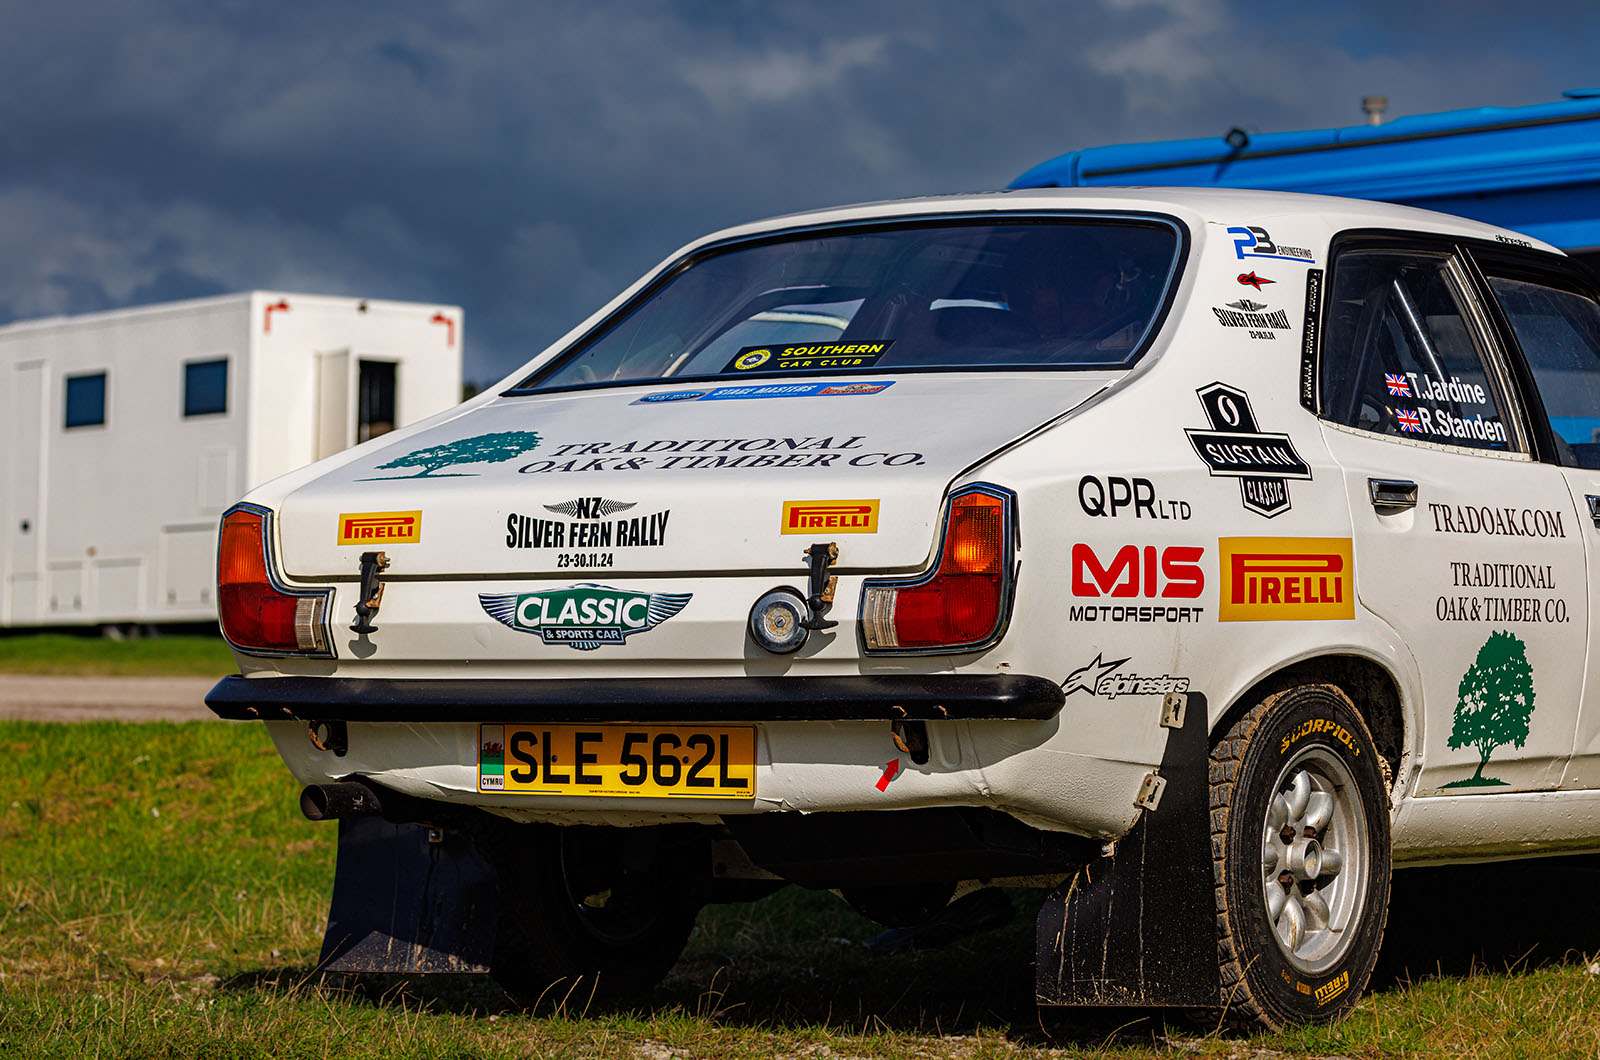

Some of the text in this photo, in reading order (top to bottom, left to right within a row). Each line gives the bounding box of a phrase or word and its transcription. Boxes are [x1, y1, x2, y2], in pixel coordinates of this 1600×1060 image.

[1227, 226, 1313, 259] PB ENGINEERING
[1239, 299, 1256, 312] NZ
[1212, 307, 1291, 329] SILVER FERN RALLY
[780, 343, 885, 357] SOUTHERN
[779, 358, 863, 368] CAR CLUB
[548, 435, 867, 457] TRADITIONAL
[1206, 443, 1297, 465] SUSTAIN
[518, 458, 616, 475] OAK
[657, 453, 842, 470] TIMBER
[848, 452, 927, 467] CO.
[1078, 474, 1192, 521] QPR LTD
[1246, 481, 1284, 505] CLASSIC
[576, 497, 602, 520] NZ
[787, 506, 872, 528] PIRELLI
[1428, 502, 1566, 538] TRADOAK.COM
[344, 516, 415, 539] PIRELLI
[506, 509, 670, 549] SILVER FERN RALLY
[557, 553, 614, 568] 23-30.11.24
[1071, 543, 1205, 598] MIS
[1231, 553, 1344, 604] PIRELLI
[1450, 561, 1556, 589] TRADITIONAL
[516, 597, 648, 627] CLASSIC
[1069, 605, 1204, 623] MOTORSPORT
[1436, 596, 1469, 621] OAK
[1484, 597, 1542, 622] TIMBER
[1545, 598, 1570, 623] CO.
[546, 629, 619, 639] & SPORTS CAR
[1097, 673, 1190, 699] alpinestars
[510, 731, 749, 788] SLE 562L
[482, 777, 504, 786] CYMRU
[1314, 970, 1350, 1008] PIRELLI
